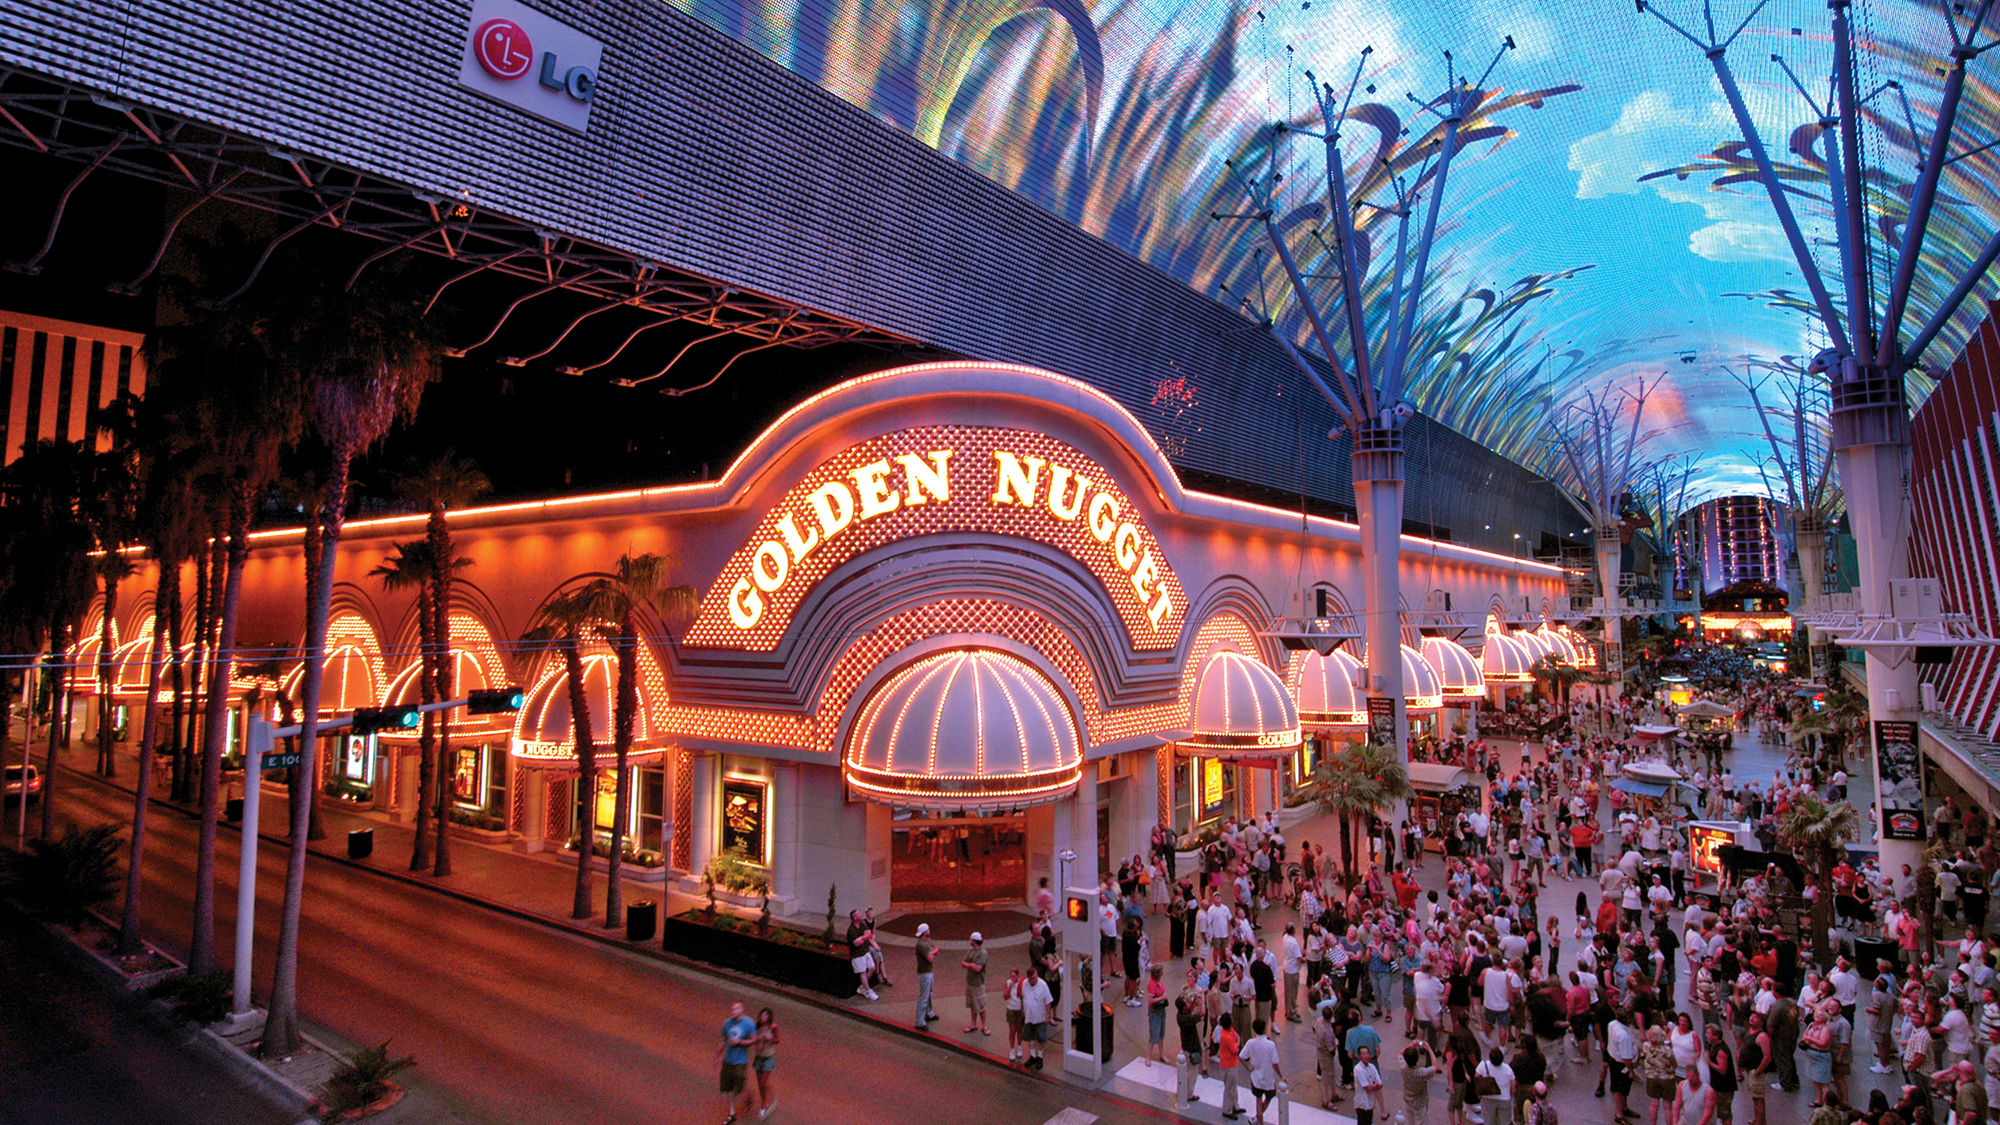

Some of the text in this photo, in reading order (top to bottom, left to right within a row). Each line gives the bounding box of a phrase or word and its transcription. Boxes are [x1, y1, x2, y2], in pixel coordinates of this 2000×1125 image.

[539, 51, 598, 104] LG
[728, 449, 1174, 634] GOLDEN NUGGET
[268, 756, 278, 767] E
[526, 744, 575, 756] NUGGET
